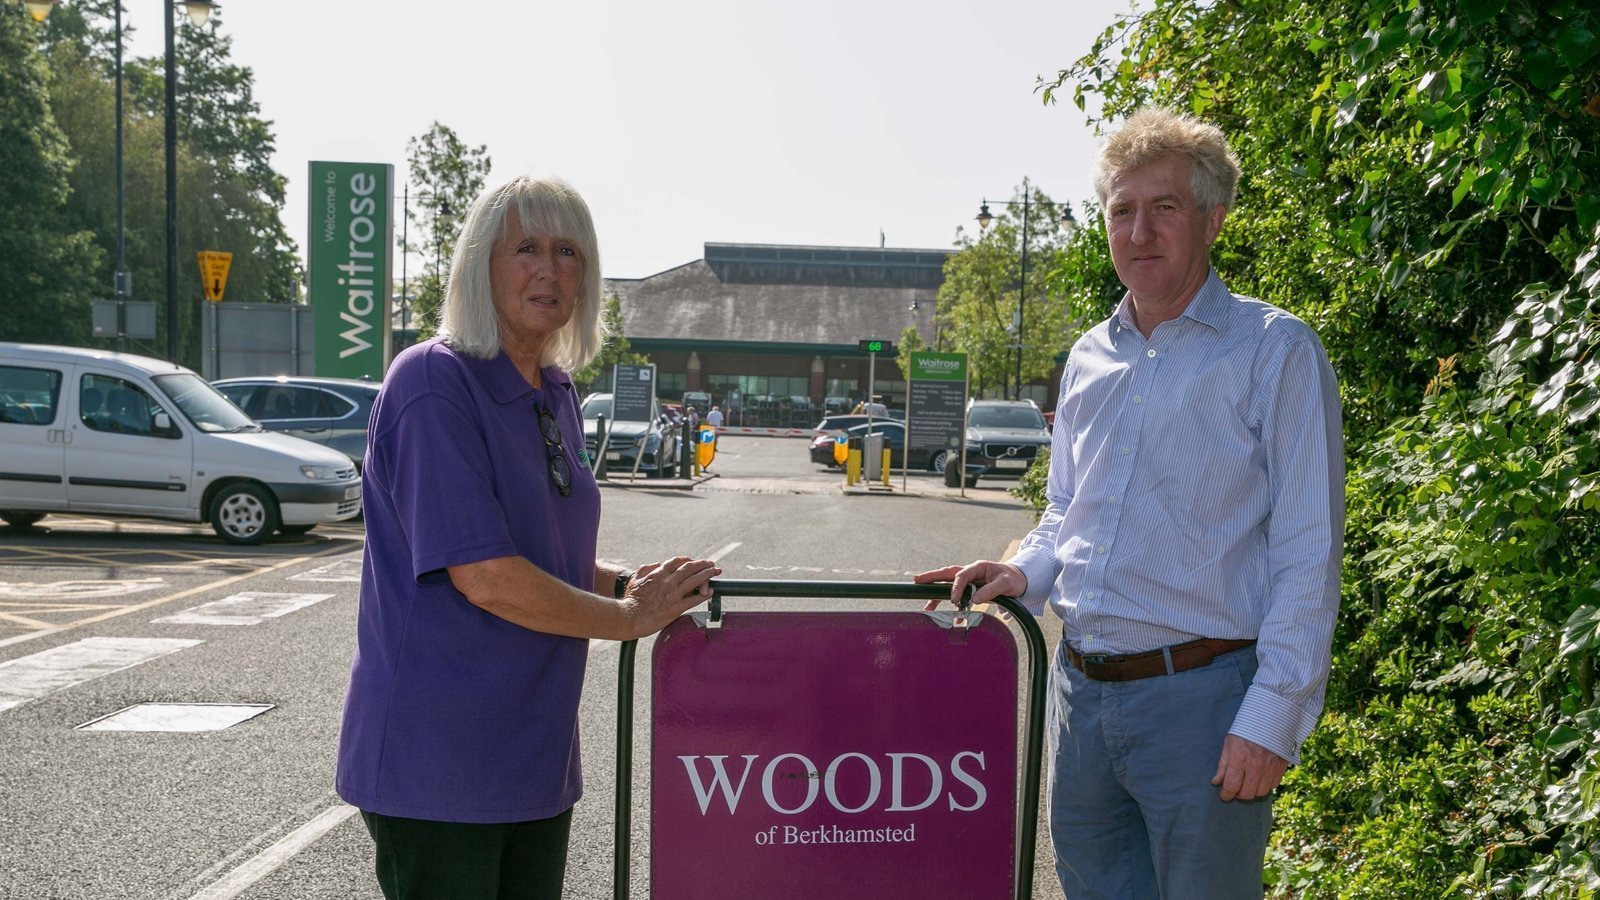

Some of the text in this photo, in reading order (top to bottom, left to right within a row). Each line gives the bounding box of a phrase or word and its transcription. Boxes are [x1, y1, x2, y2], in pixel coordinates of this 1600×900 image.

[324, 170, 336, 243] Welcome to
[337, 172, 376, 359] Waitrose
[868, 341, 882, 351] 68
[918, 358, 960, 369] Waitrose
[677, 750, 988, 816] WOODS
[754, 823, 916, 845] of Berkhamsted
